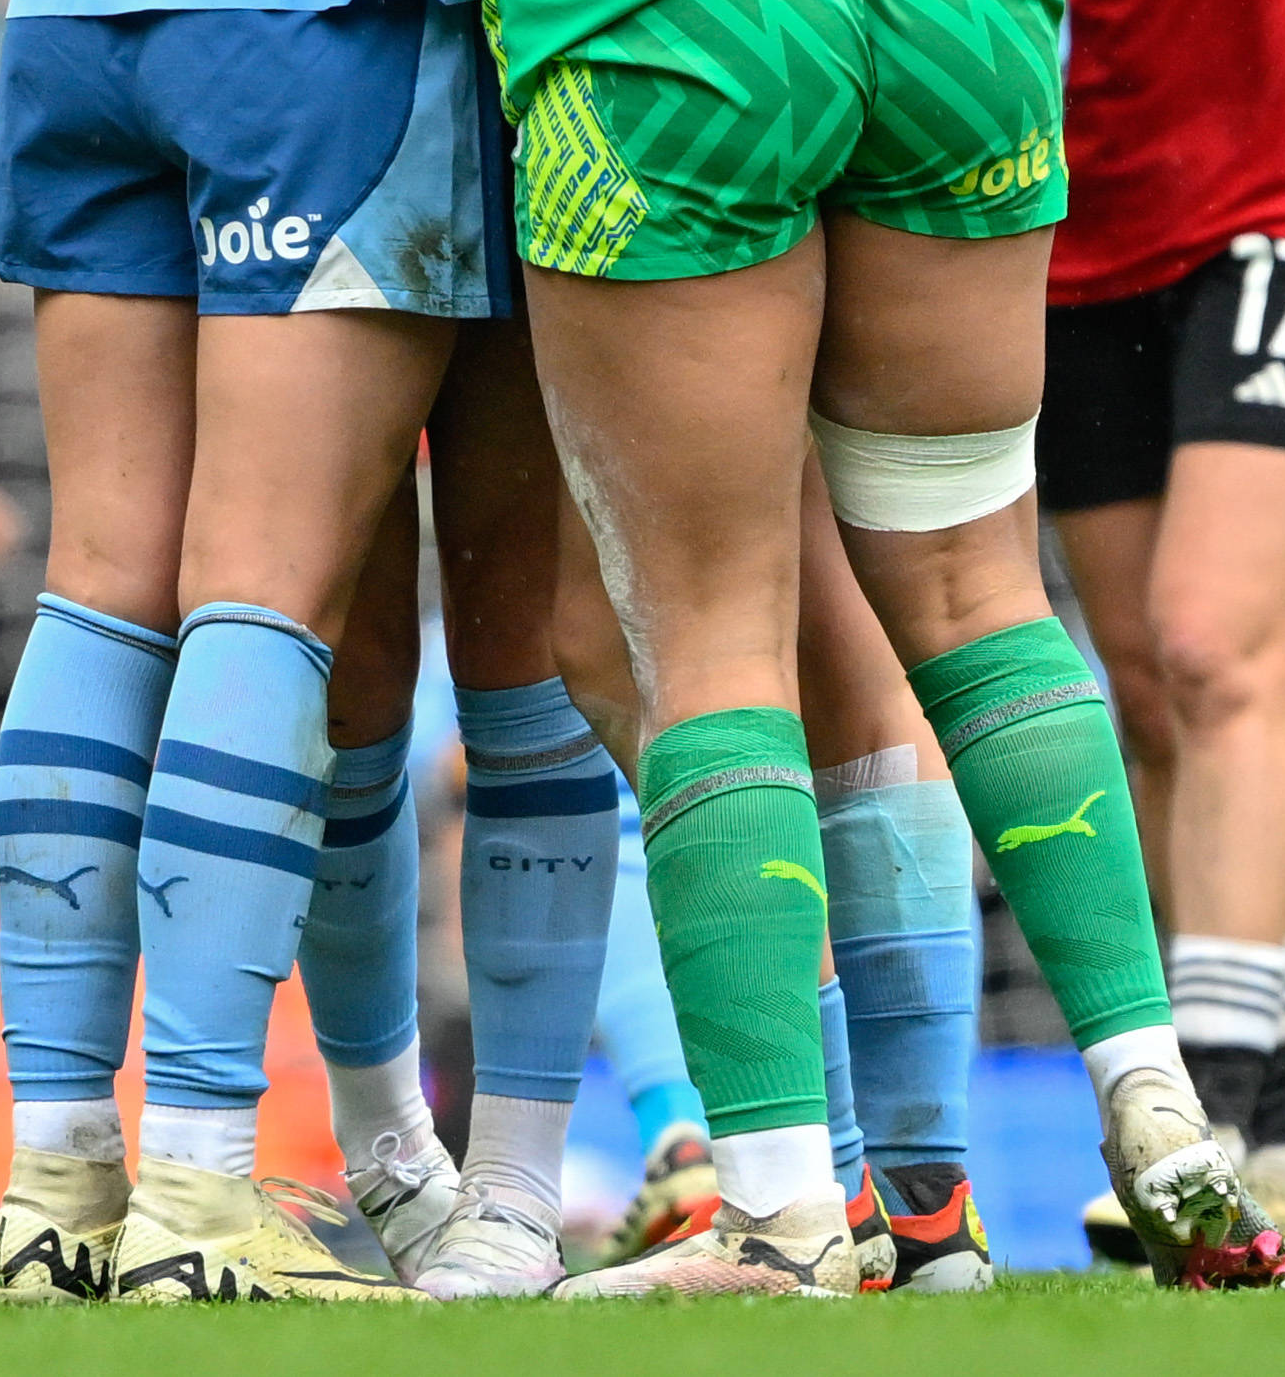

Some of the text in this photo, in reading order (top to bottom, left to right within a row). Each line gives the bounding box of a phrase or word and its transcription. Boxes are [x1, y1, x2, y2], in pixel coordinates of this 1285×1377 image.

[948, 126, 1051, 196] Joie
[199, 196, 310, 267] Joie
[489, 854, 594, 874] CITY
